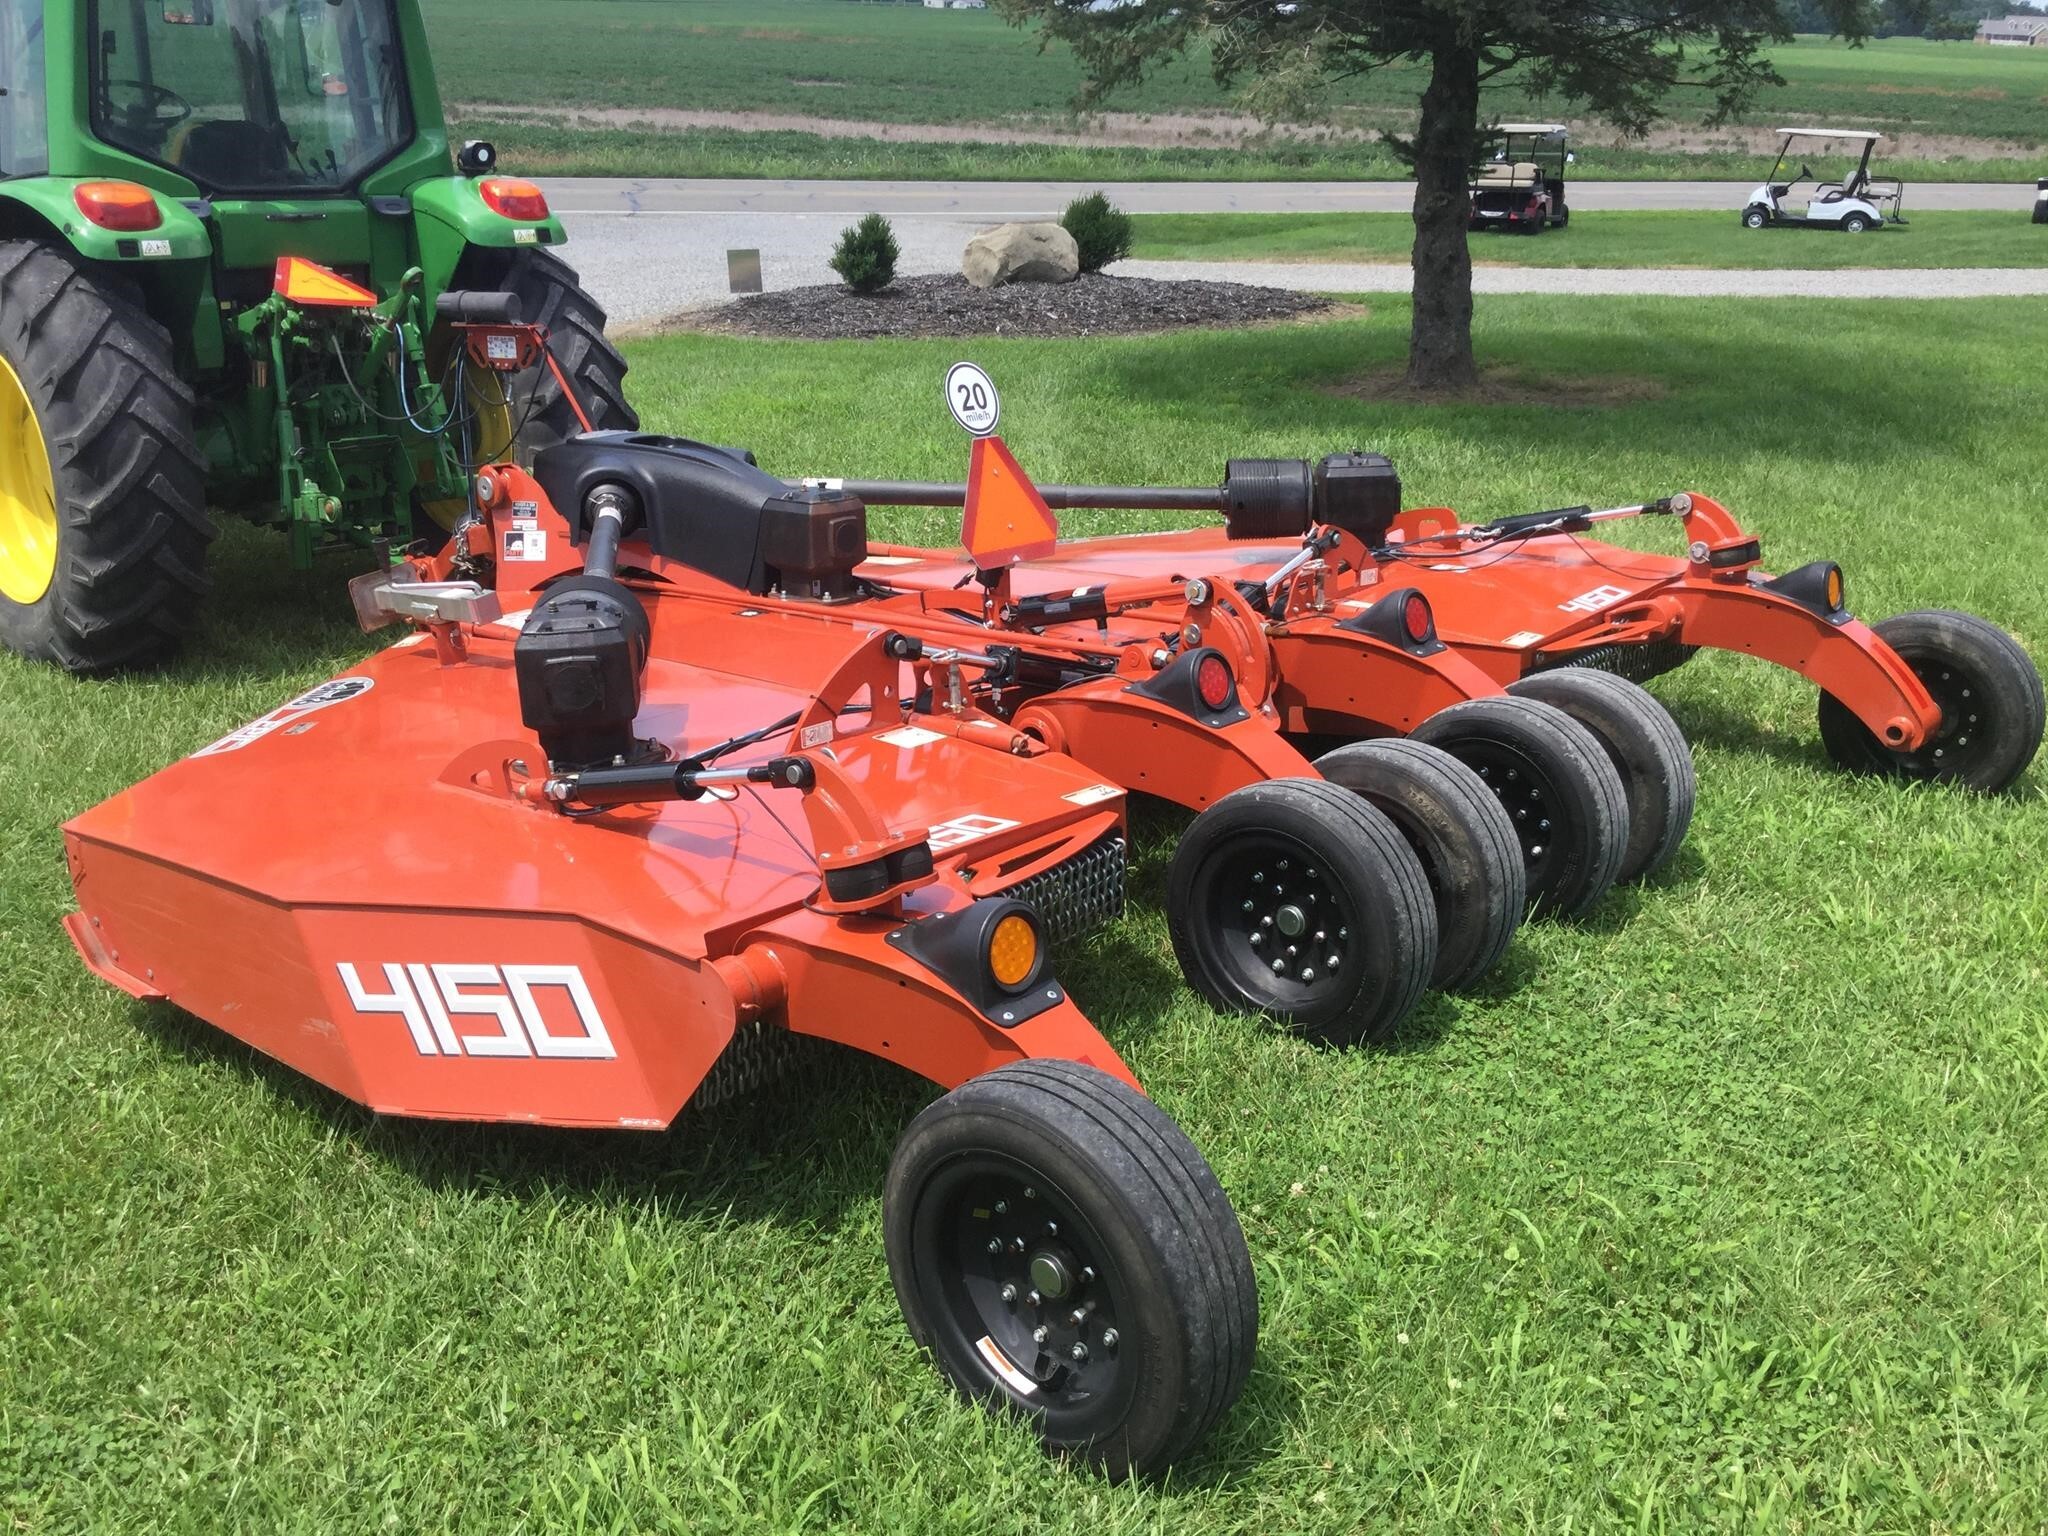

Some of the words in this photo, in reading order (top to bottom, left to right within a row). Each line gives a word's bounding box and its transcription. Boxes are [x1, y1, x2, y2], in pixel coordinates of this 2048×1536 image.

[957, 383, 987, 411] 20
[966, 411, 990, 421] mile/h
[1557, 585, 1632, 612] 4150
[927, 813, 1022, 851] 150
[336, 962, 617, 1059] 4150
